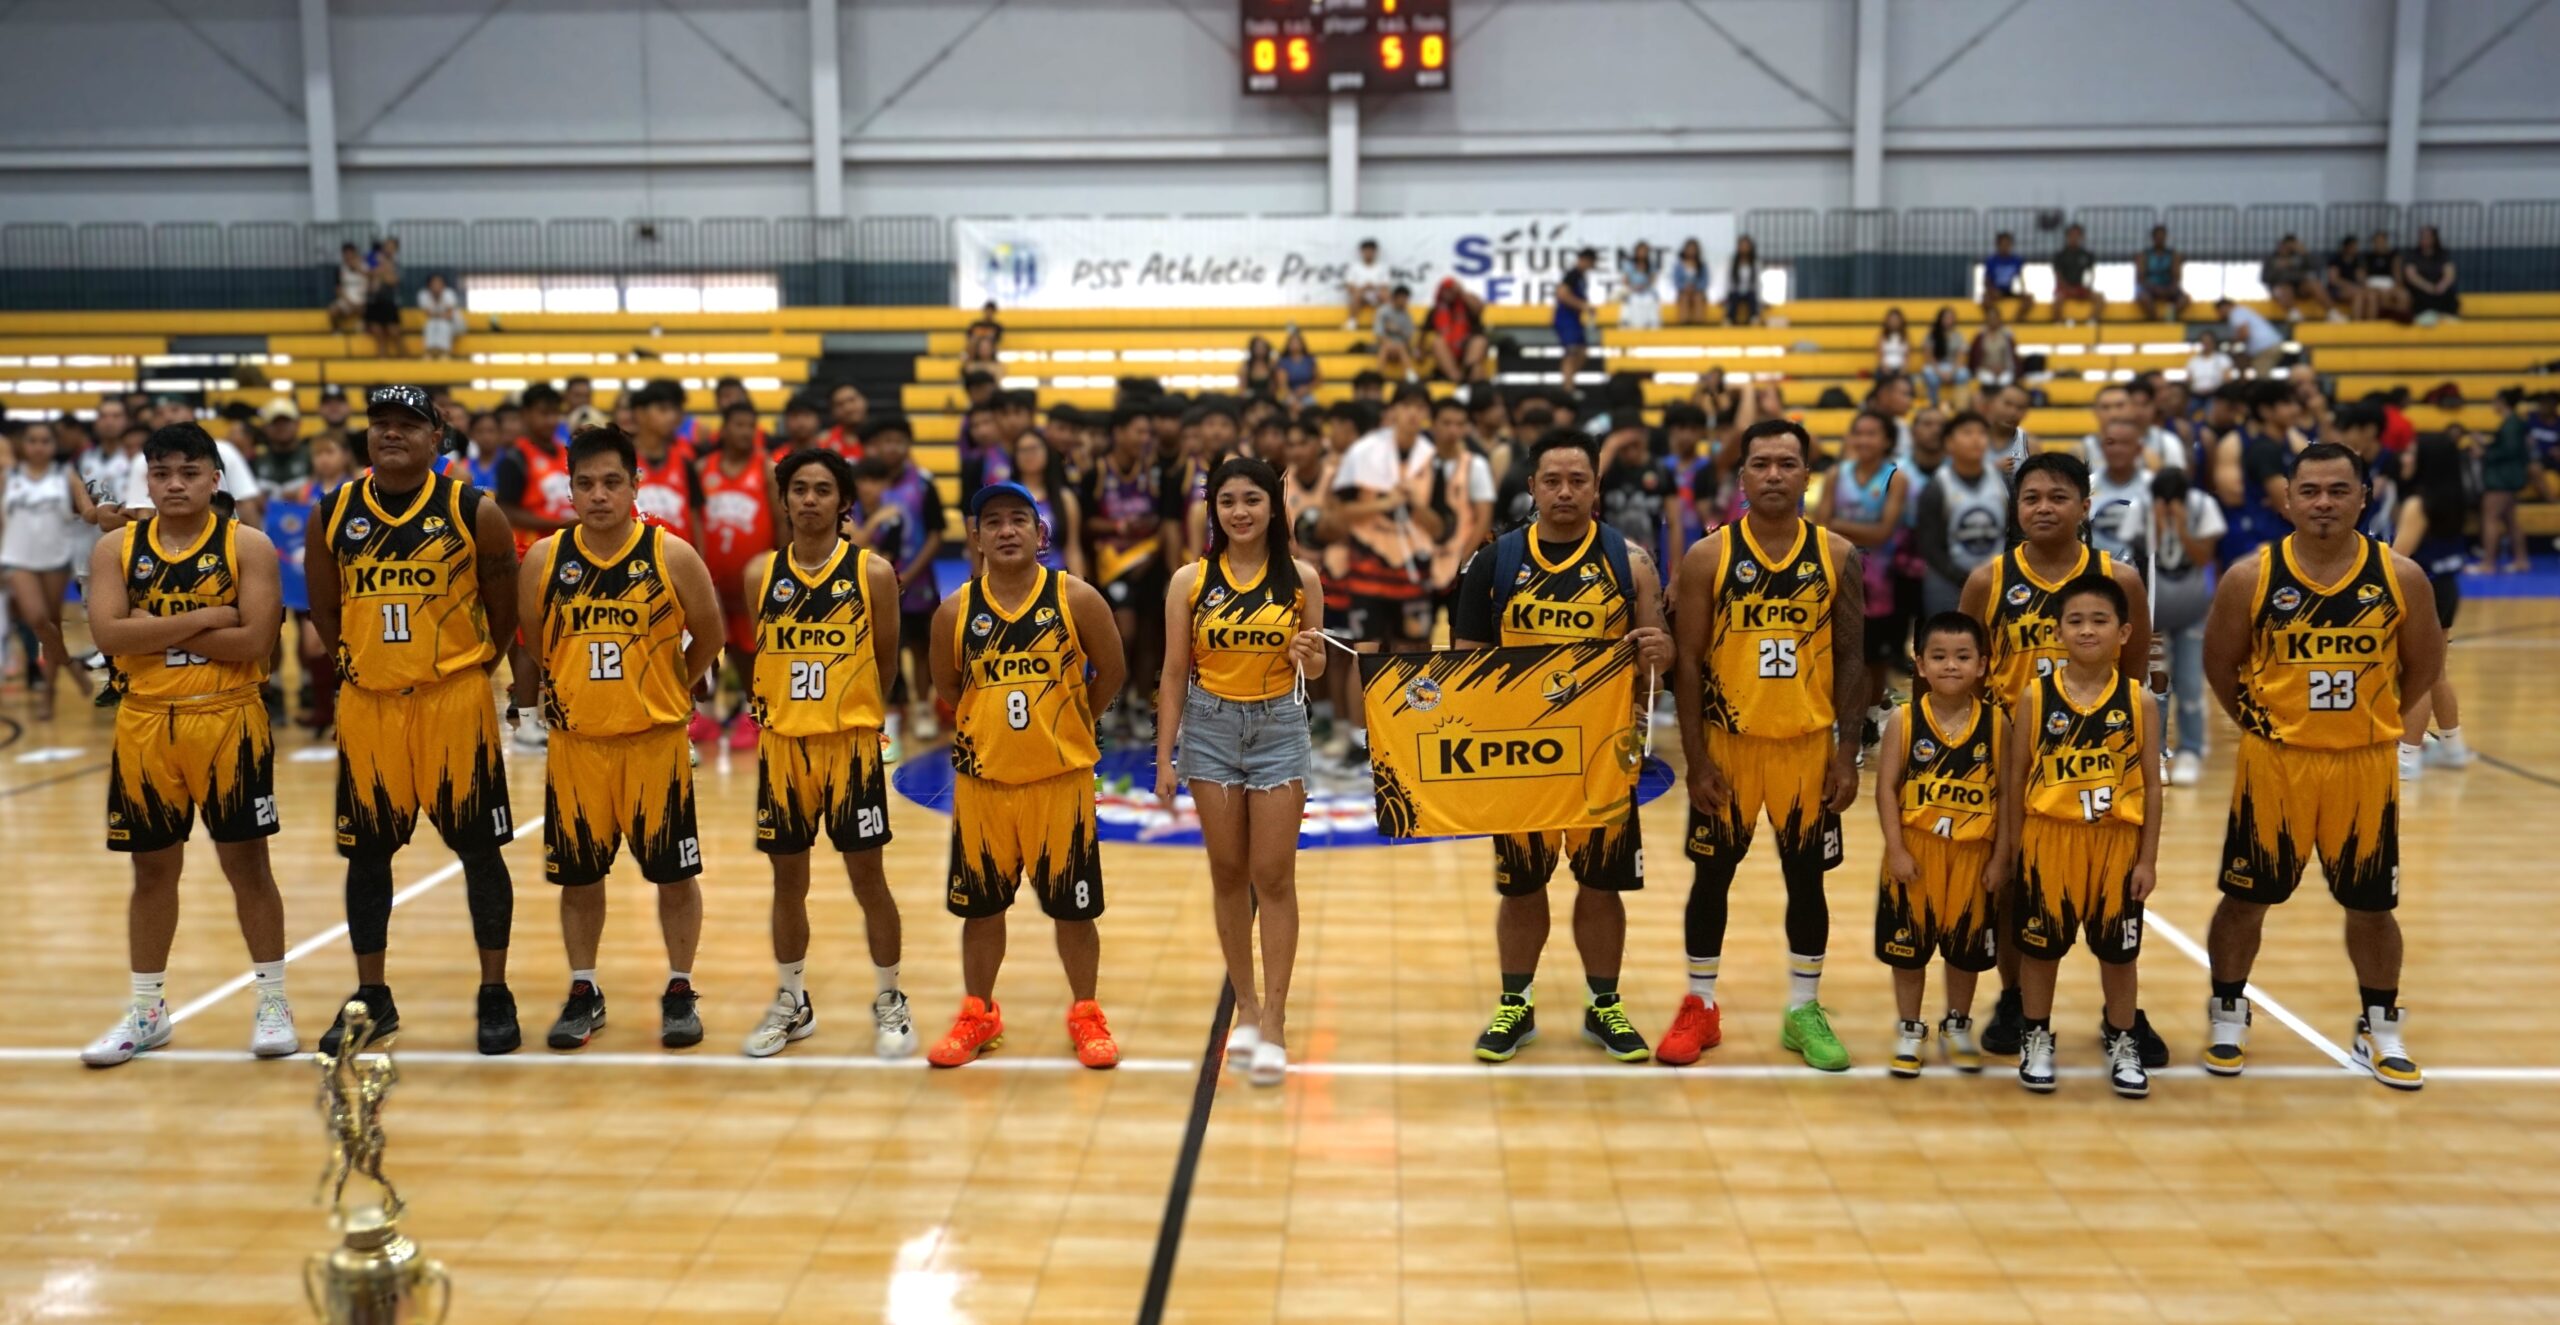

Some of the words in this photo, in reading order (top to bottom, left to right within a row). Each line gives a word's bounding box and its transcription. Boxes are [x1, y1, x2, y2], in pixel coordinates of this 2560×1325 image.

[1253, 38, 1277, 72] 0
[1287, 37, 1310, 72] 5
[1380, 35, 1403, 69] 5
[1420, 34, 1443, 69] 0
[1137, 252, 1265, 285] Athletic
[356, 566, 436, 593] KPRO
[382, 603, 411, 643] 11
[572, 605, 638, 631] KPRO
[589, 641, 623, 680] 12
[1759, 638, 1798, 678] 25
[2287, 632, 2377, 659] KPRO
[790, 661, 826, 700] 20
[983, 658, 1050, 682] KPRO
[2308, 671, 2357, 711] 23
[1006, 690, 1030, 731] 8
[254, 795, 277, 827] 20
[492, 806, 508, 837] 11
[857, 805, 884, 838] 20
[678, 837, 700, 868] 12
[1075, 880, 1089, 909] 8
[2122, 918, 2137, 950] 15
